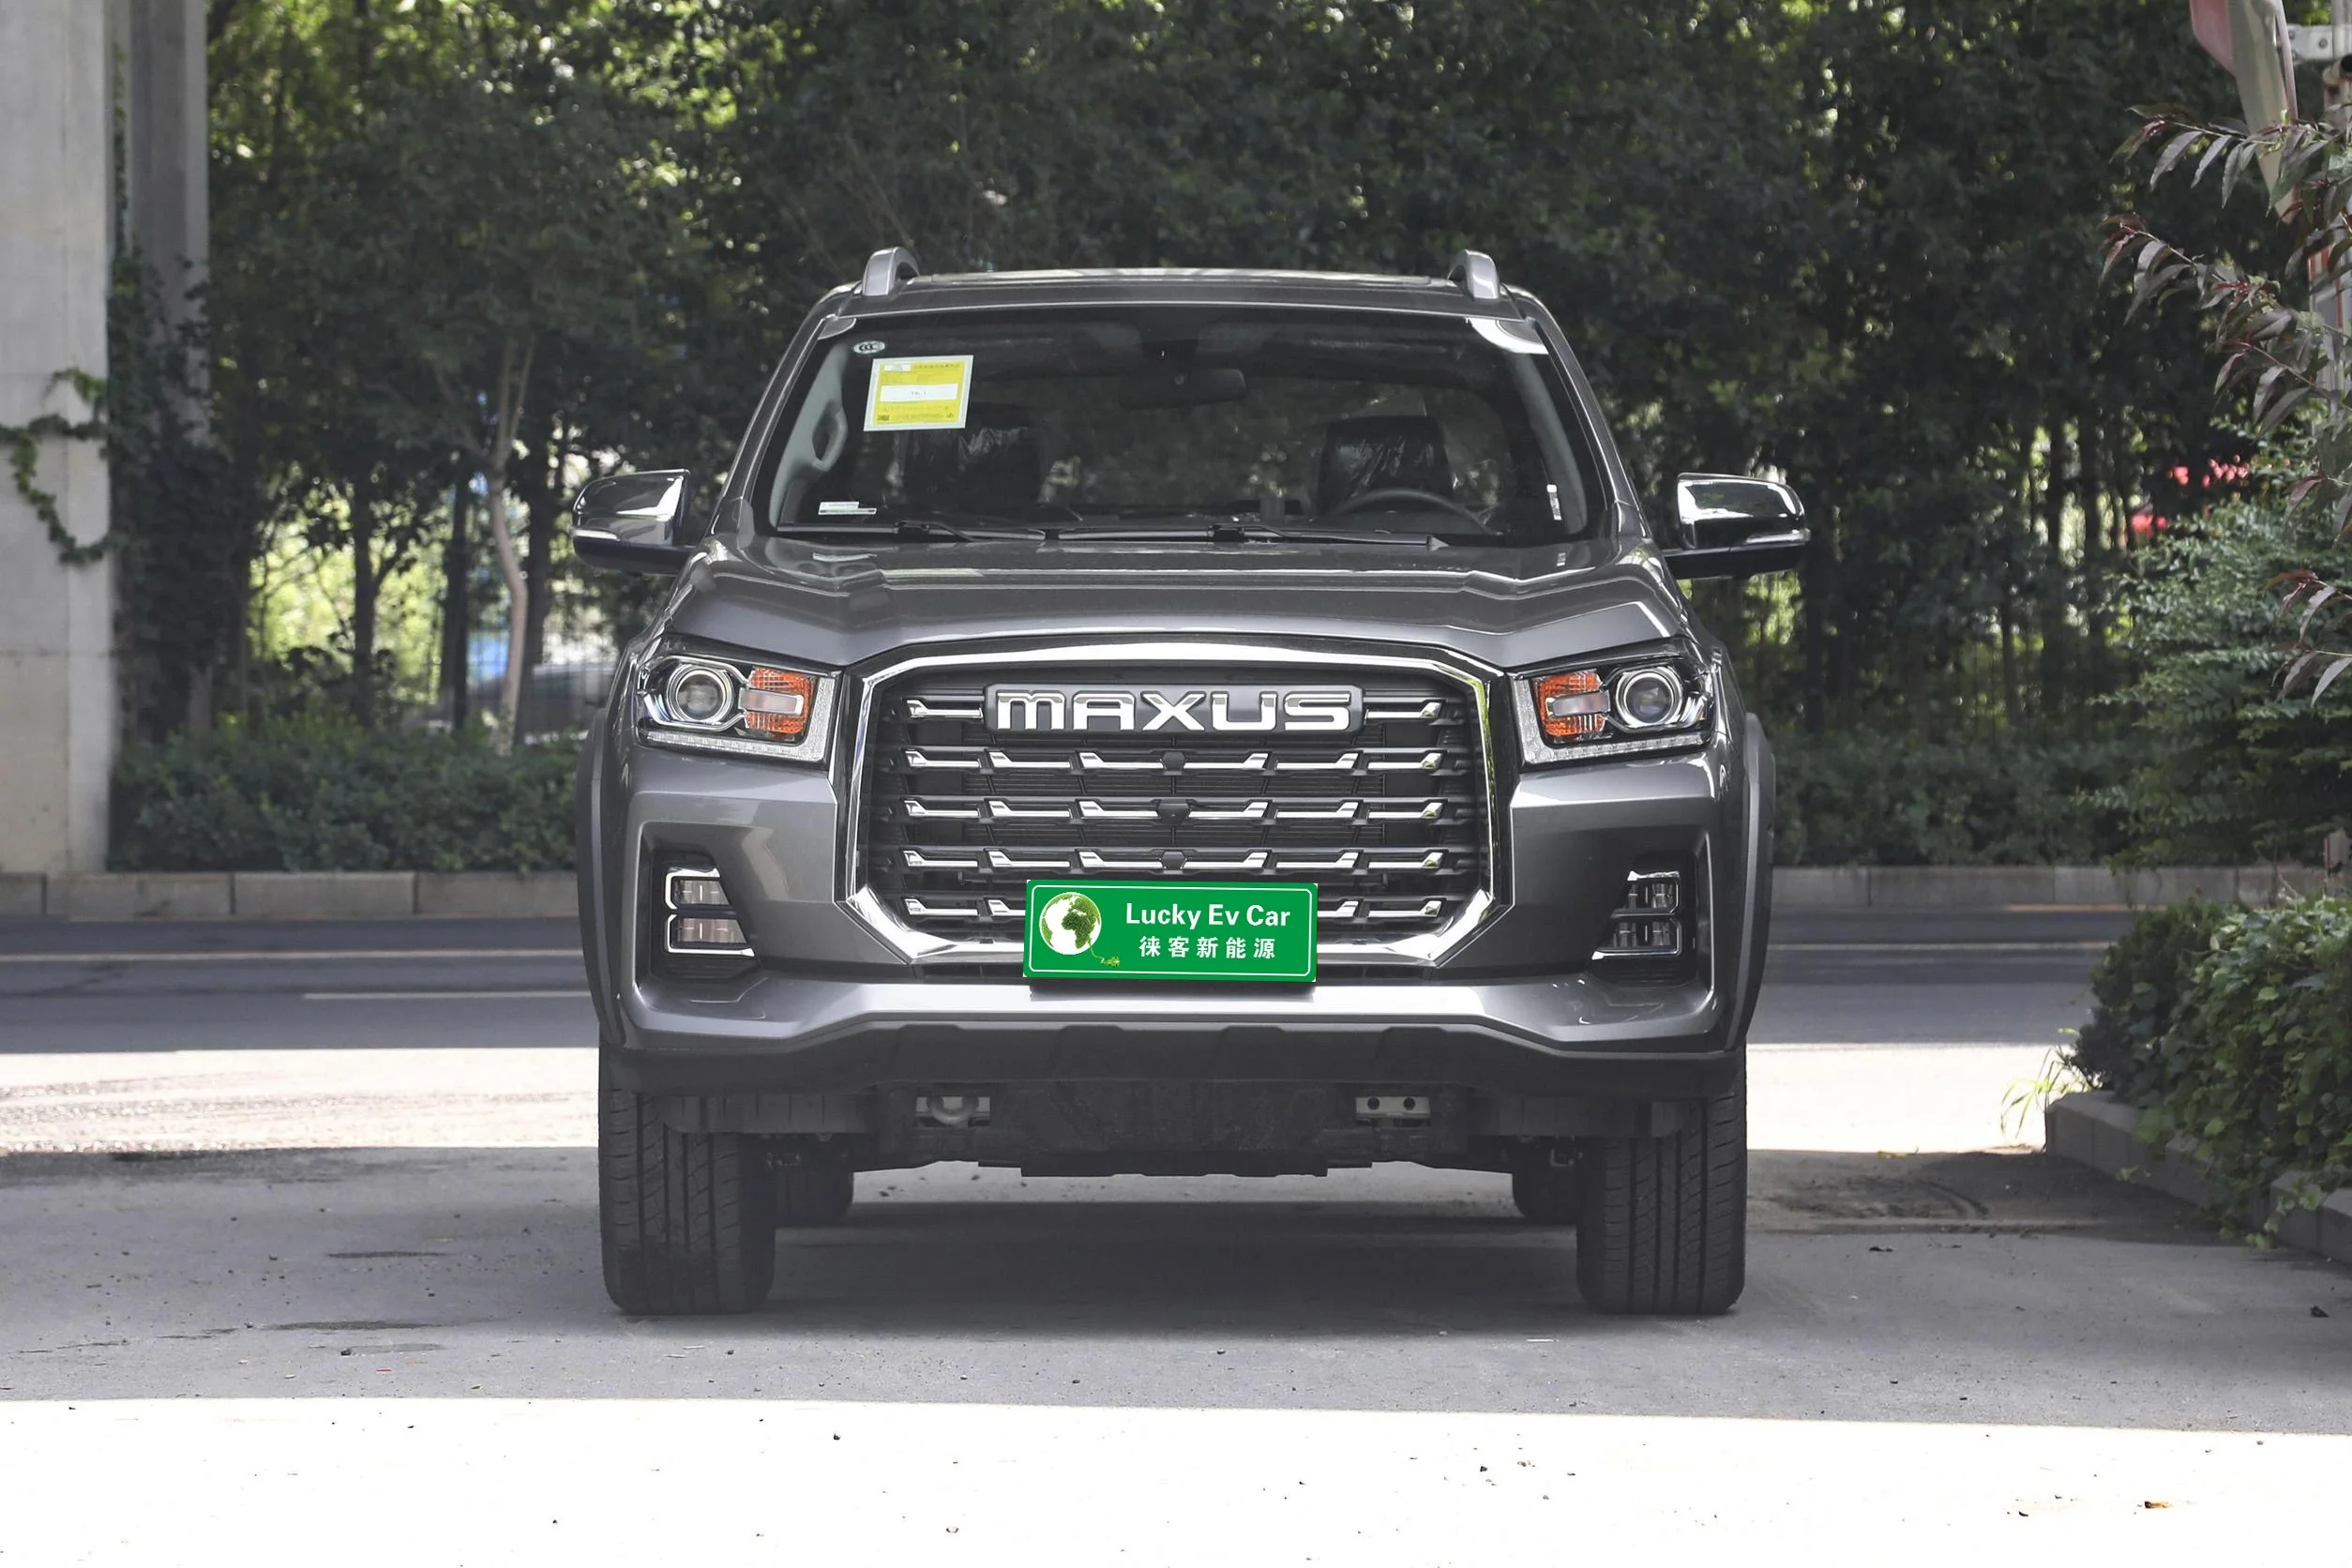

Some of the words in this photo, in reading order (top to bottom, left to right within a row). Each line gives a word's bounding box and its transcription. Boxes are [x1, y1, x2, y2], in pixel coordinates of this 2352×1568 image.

[996, 690, 1350, 731] MAXUS
[1125, 902, 1201, 929] Lucky
[1208, 904, 1240, 926] Ev
[1245, 905, 1290, 927] Car
[1138, 936, 1275, 959] 徕客新能源
